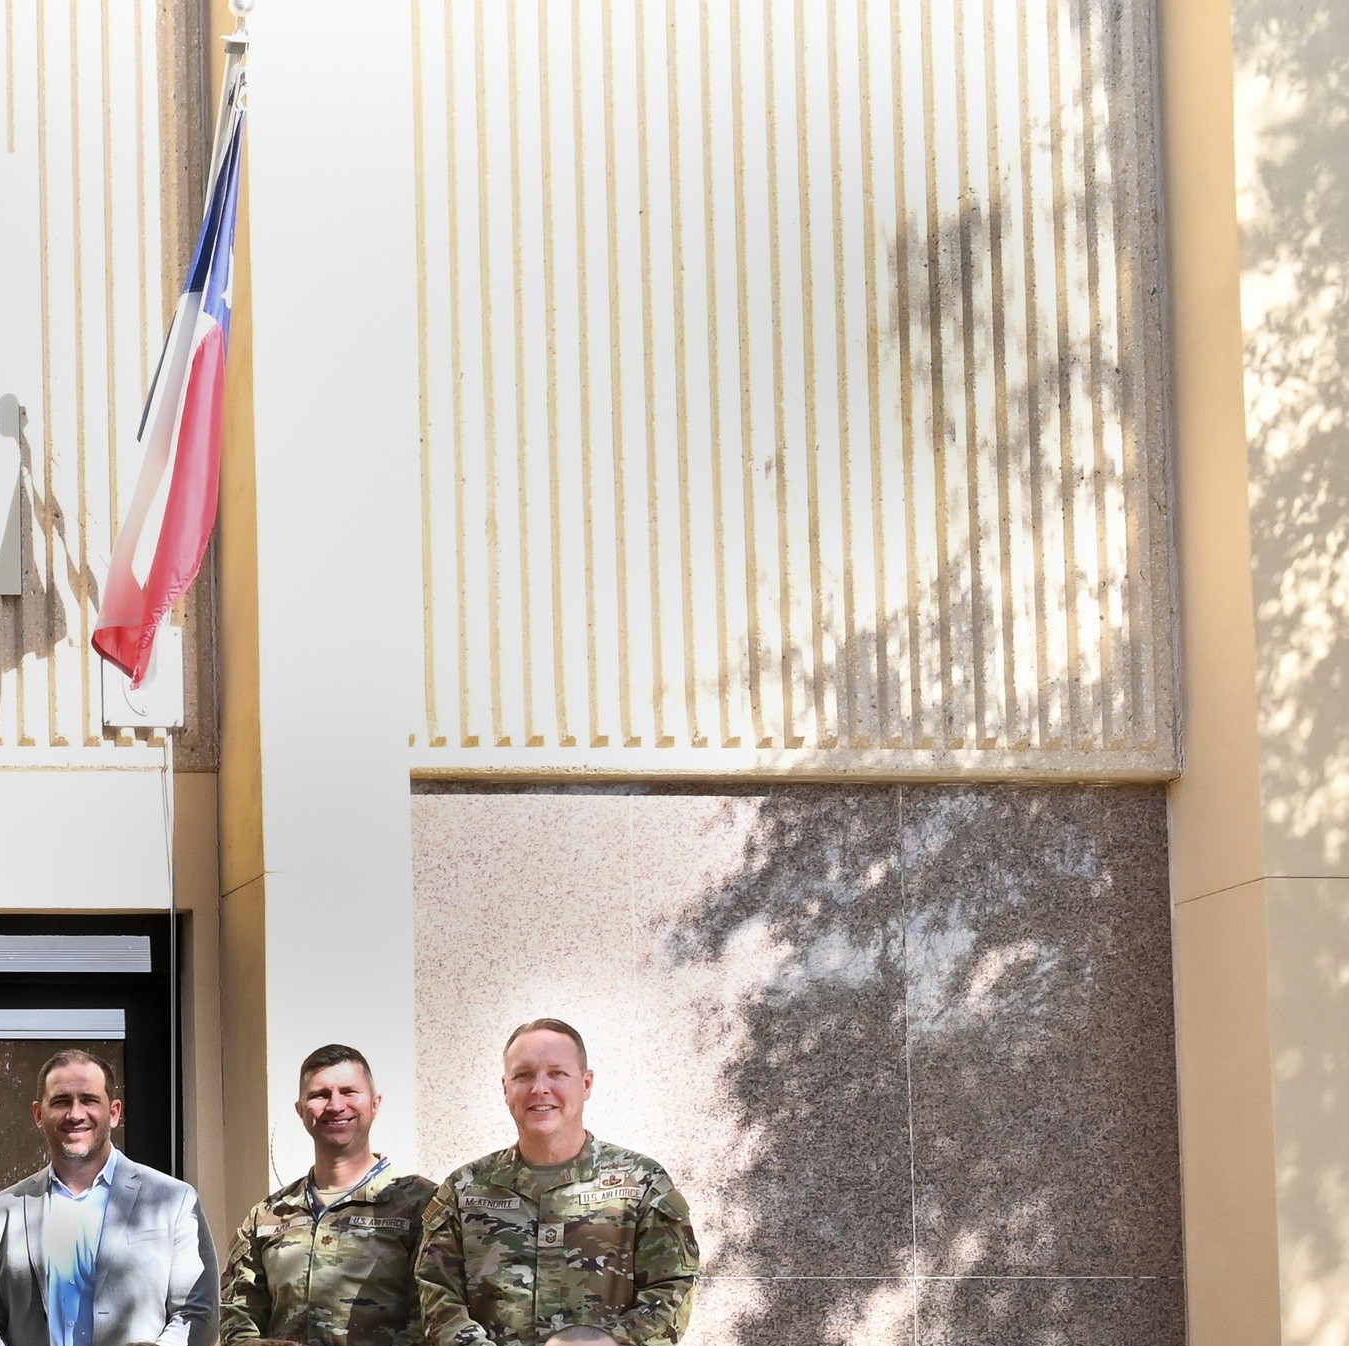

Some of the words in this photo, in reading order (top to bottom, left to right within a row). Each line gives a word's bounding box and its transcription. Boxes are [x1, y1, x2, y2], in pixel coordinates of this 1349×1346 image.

[583, 1193, 597, 1202] U.S.
[601, 1191, 613, 1200] AIR
[614, 1188, 641, 1199] FORCE
[465, 1198, 512, 1208] McKENDREE
[353, 1217, 367, 1226] U.S.
[369, 1218, 382, 1226] AIR
[382, 1218, 406, 1229] FORCE
